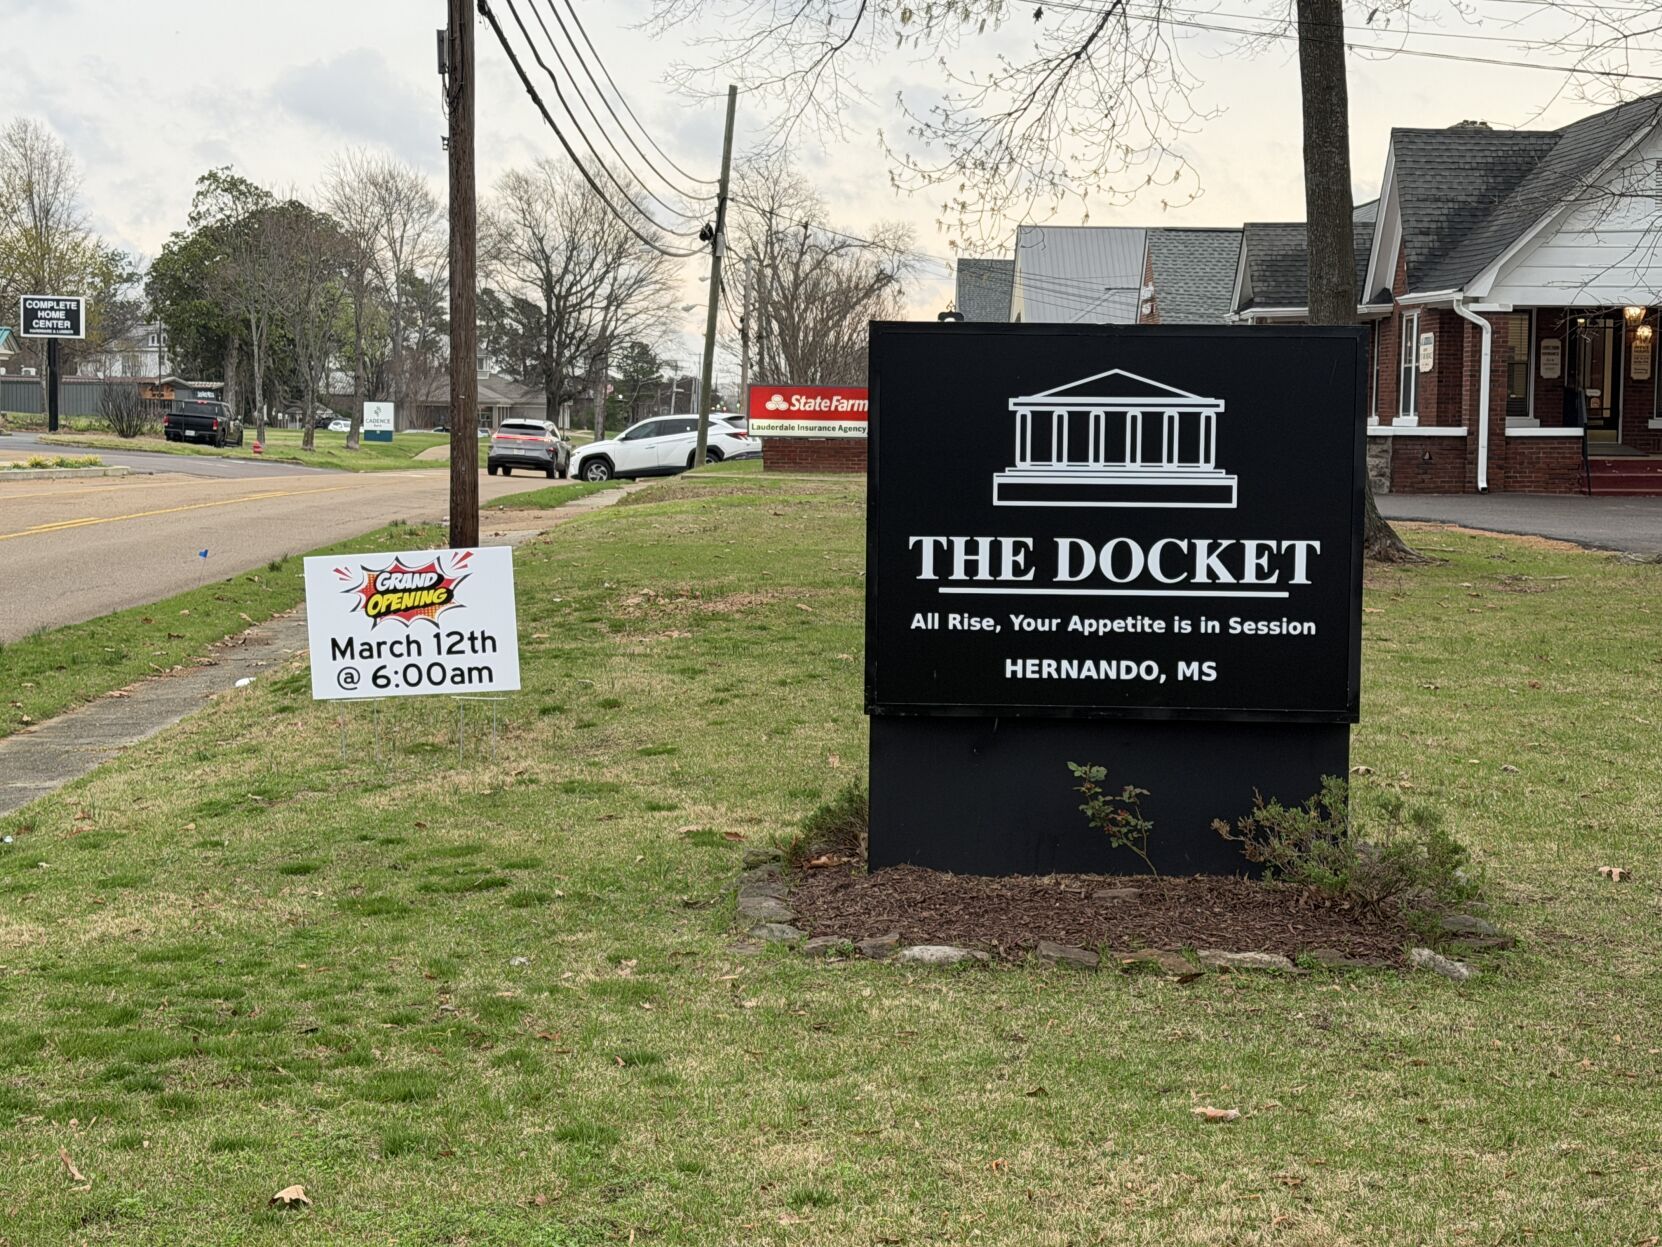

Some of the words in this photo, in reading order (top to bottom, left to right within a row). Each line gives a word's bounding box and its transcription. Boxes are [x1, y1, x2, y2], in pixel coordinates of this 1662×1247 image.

[25, 300, 78, 310] COMPLETE
[37, 310, 66, 319] HOME
[32, 319, 71, 328] CENTER
[751, 423, 796, 431] Lauderdale
[797, 424, 836, 432] Insurance
[838, 424, 867, 434] Agency
[909, 536, 1036, 581] THE
[1052, 537, 1321, 585] DOCKET
[375, 572, 438, 592] GRAND
[366, 588, 448, 616] OPENING
[910, 612, 940, 630] All
[948, 613, 1002, 634] Rise,
[1009, 614, 1062, 632] Your
[1067, 615, 1167, 636] Appetite
[1173, 616, 1193, 633] is
[1200, 616, 1221, 634] in
[1228, 617, 1316, 635] Session
[331, 634, 422, 661] March
[433, 630, 498, 656] 12th
[337, 666, 361, 691] @
[371, 662, 494, 689] 6:00am
[1005, 658, 1167, 684] HERNANDO,
[1177, 661, 1218, 682] MS
